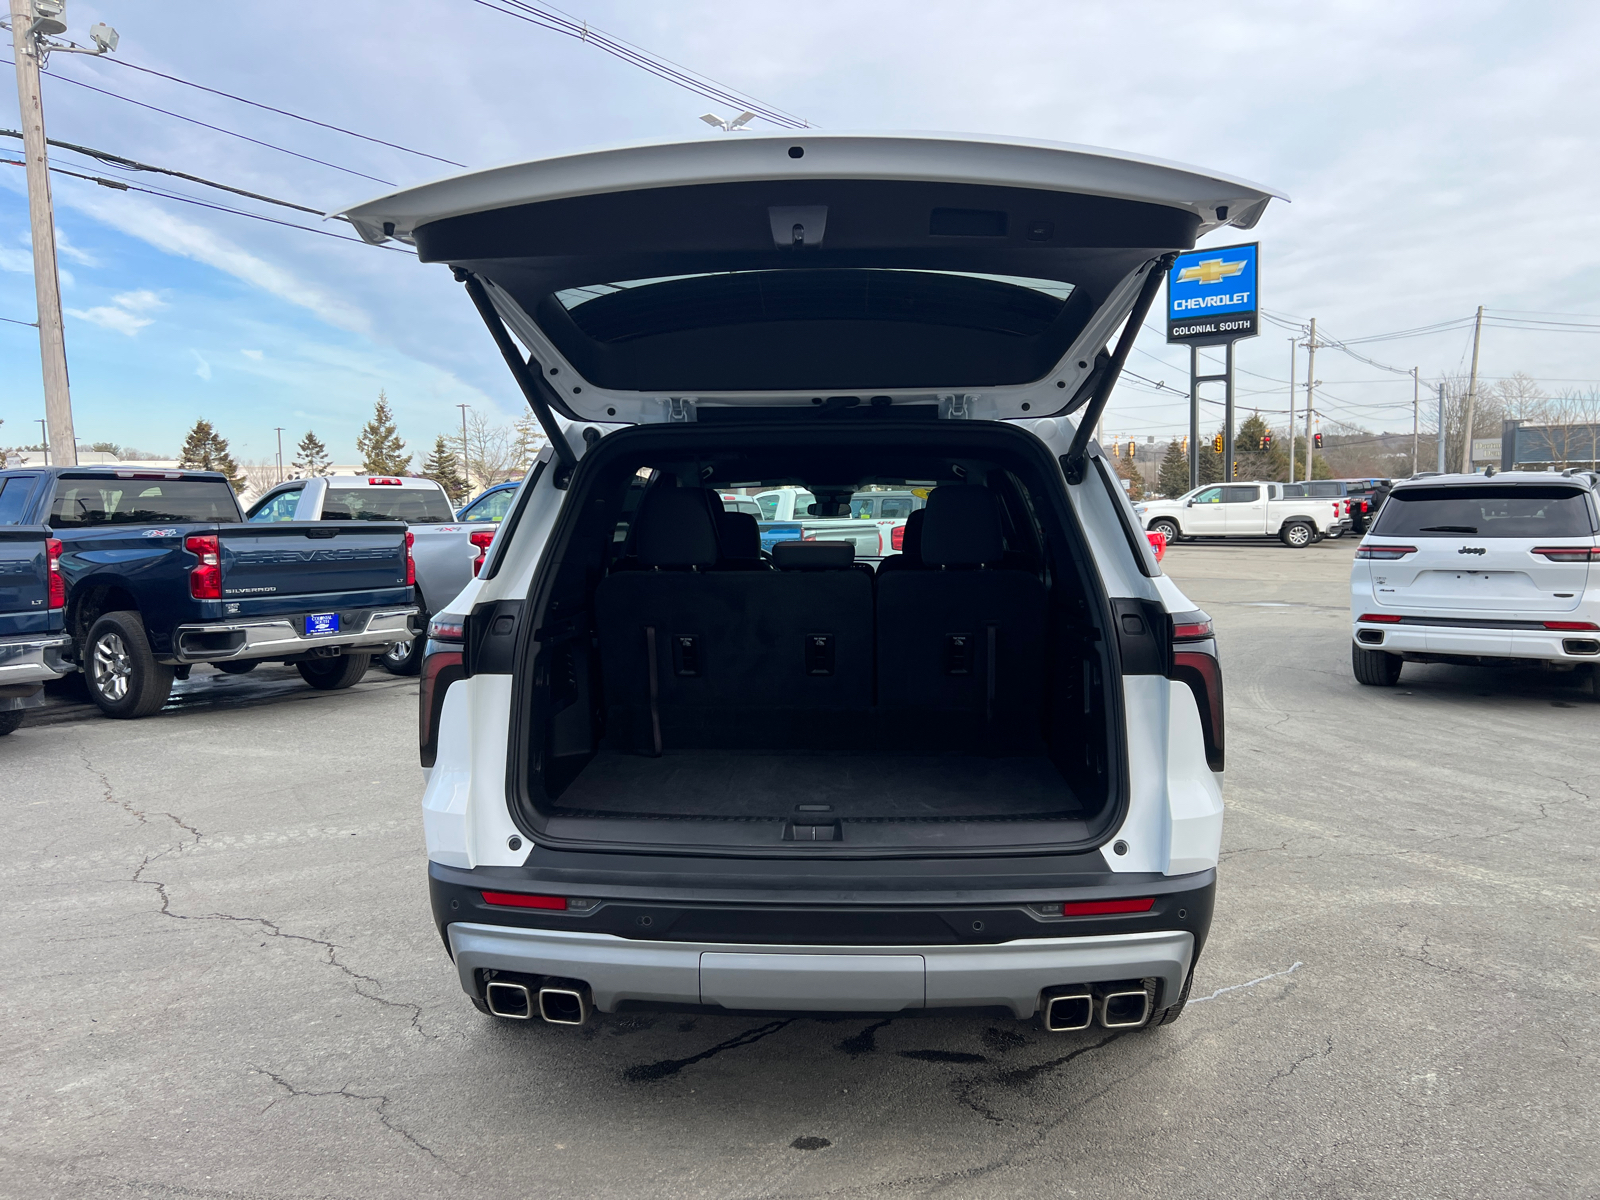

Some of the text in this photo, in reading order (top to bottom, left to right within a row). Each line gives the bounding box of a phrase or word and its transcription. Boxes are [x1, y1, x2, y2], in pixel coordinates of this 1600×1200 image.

[1174, 292, 1250, 310] CHEVROLET
[1173, 320, 1251, 336] COLONIAL SOUTH
[236, 549, 398, 564] CHEVROLET
[1457, 545, 1487, 557] Jeep
[225, 586, 277, 594] SILVERADO
